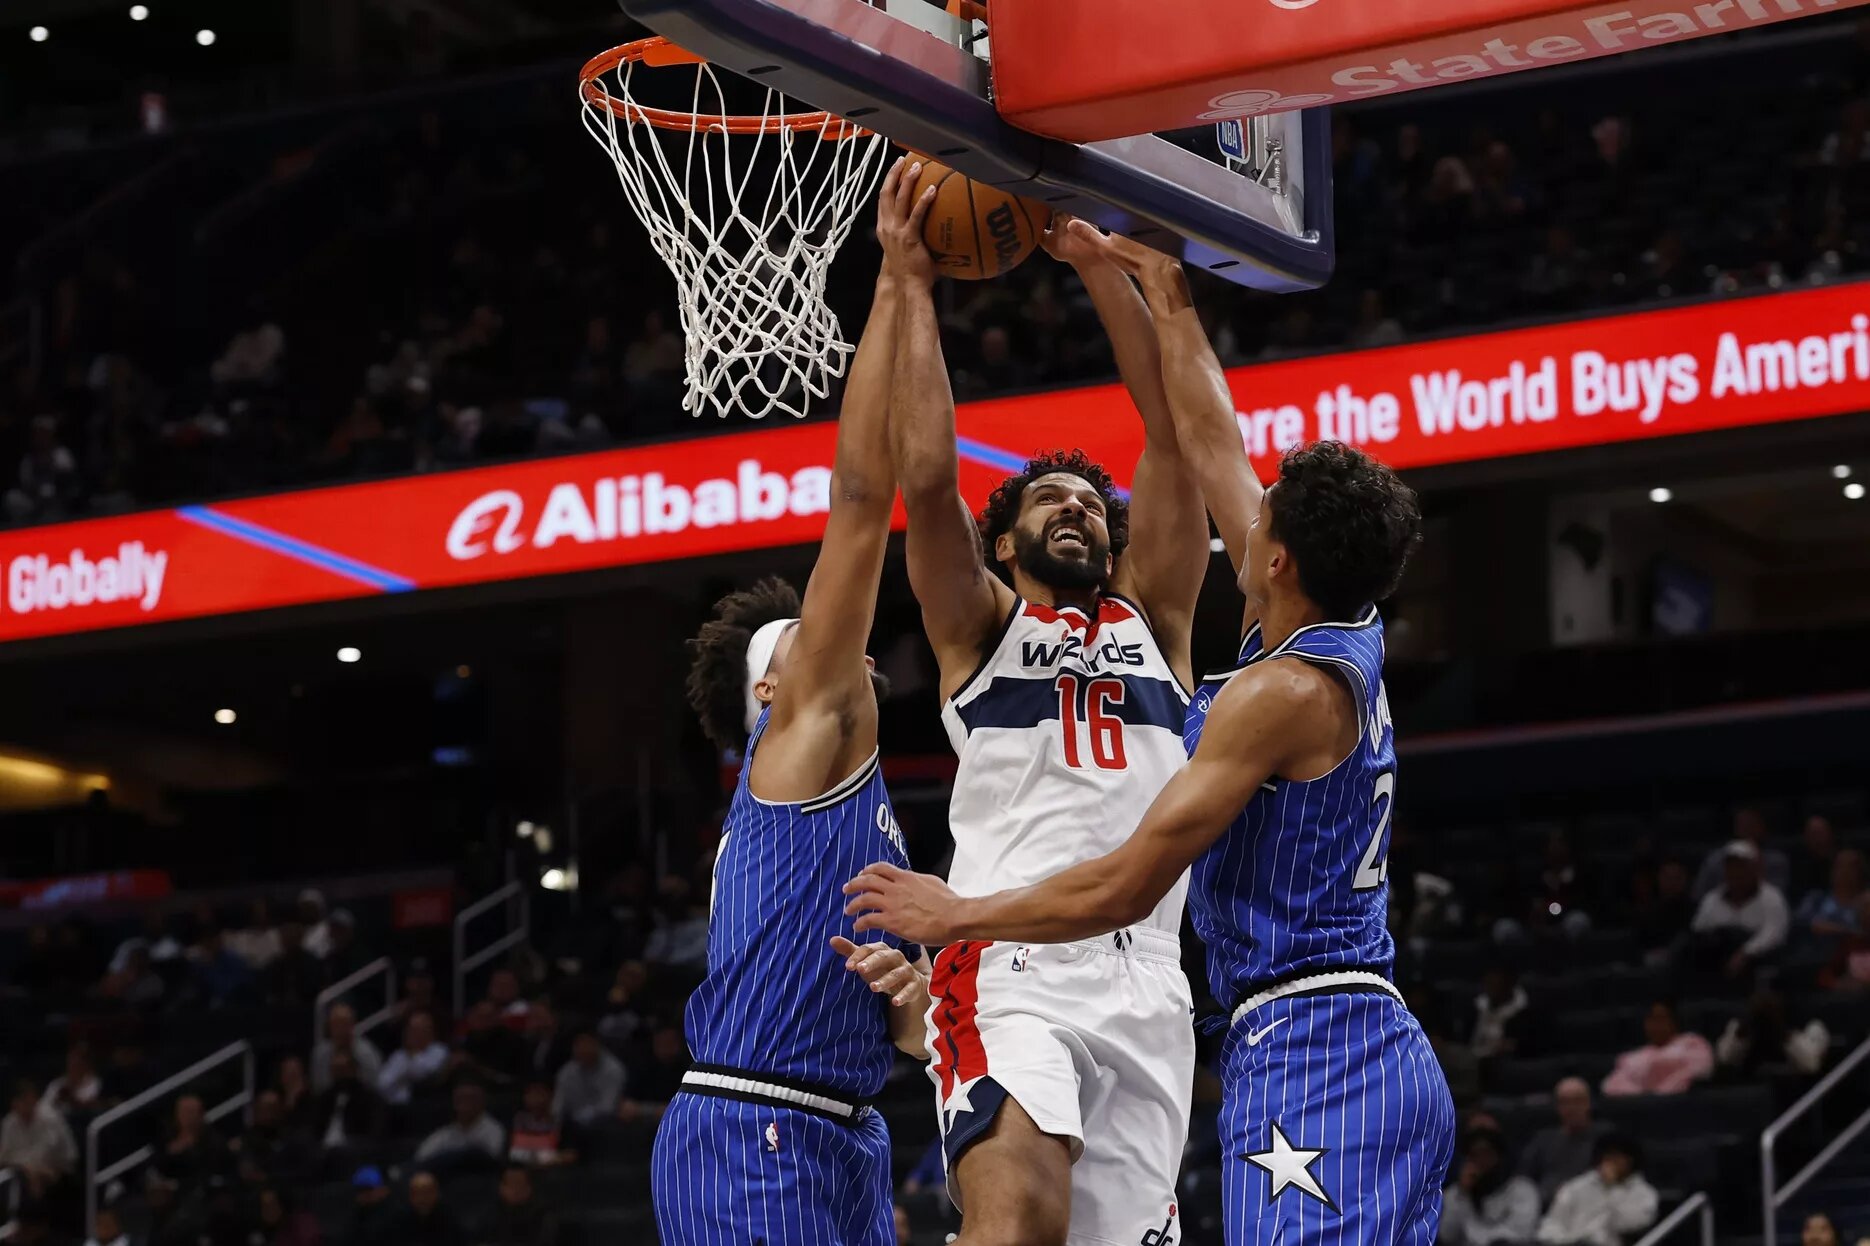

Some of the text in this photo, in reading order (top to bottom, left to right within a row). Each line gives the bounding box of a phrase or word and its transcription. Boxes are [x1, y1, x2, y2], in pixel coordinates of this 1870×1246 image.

[1221, 119, 1239, 150] NBA
[1315, 384, 1400, 446] the
[1410, 355, 1558, 436] World
[1571, 350, 1699, 424] Buys
[532, 459, 832, 549] Alibaba
[8, 540, 168, 614] Globally
[1055, 673, 1128, 771] 16
